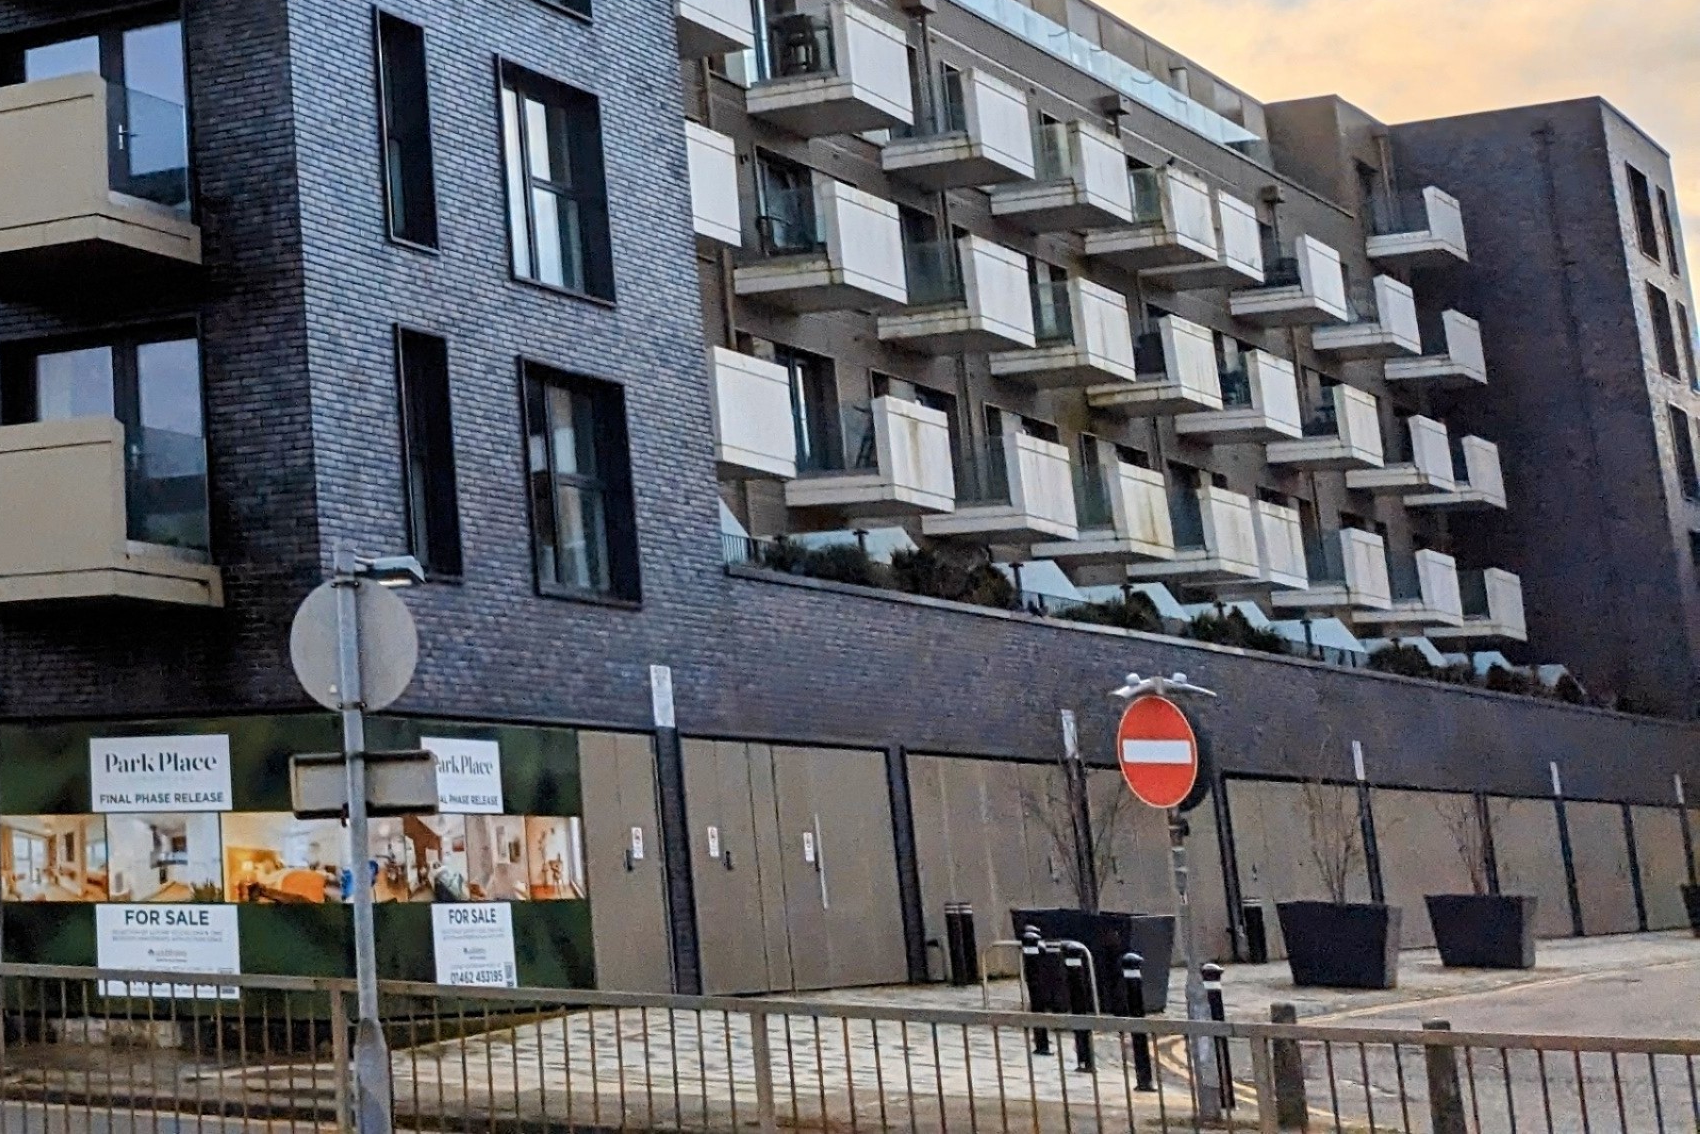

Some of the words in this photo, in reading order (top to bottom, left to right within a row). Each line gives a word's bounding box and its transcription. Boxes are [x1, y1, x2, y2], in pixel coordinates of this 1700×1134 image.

[105, 752, 154, 773] Park
[159, 752, 217, 772] Place
[438, 755, 460, 774] ark
[461, 755, 493, 775] Place
[100, 793, 132, 804] FINAL
[135, 792, 171, 804] PHASE
[174, 791, 223, 803] RELEASE
[449, 794, 469, 805] PHASE
[471, 794, 498, 806] RELEASE
[125, 909, 160, 926] FOR
[165, 909, 209, 926] SALE
[449, 908, 469, 924] FOR
[471, 908, 497, 924] SALE
